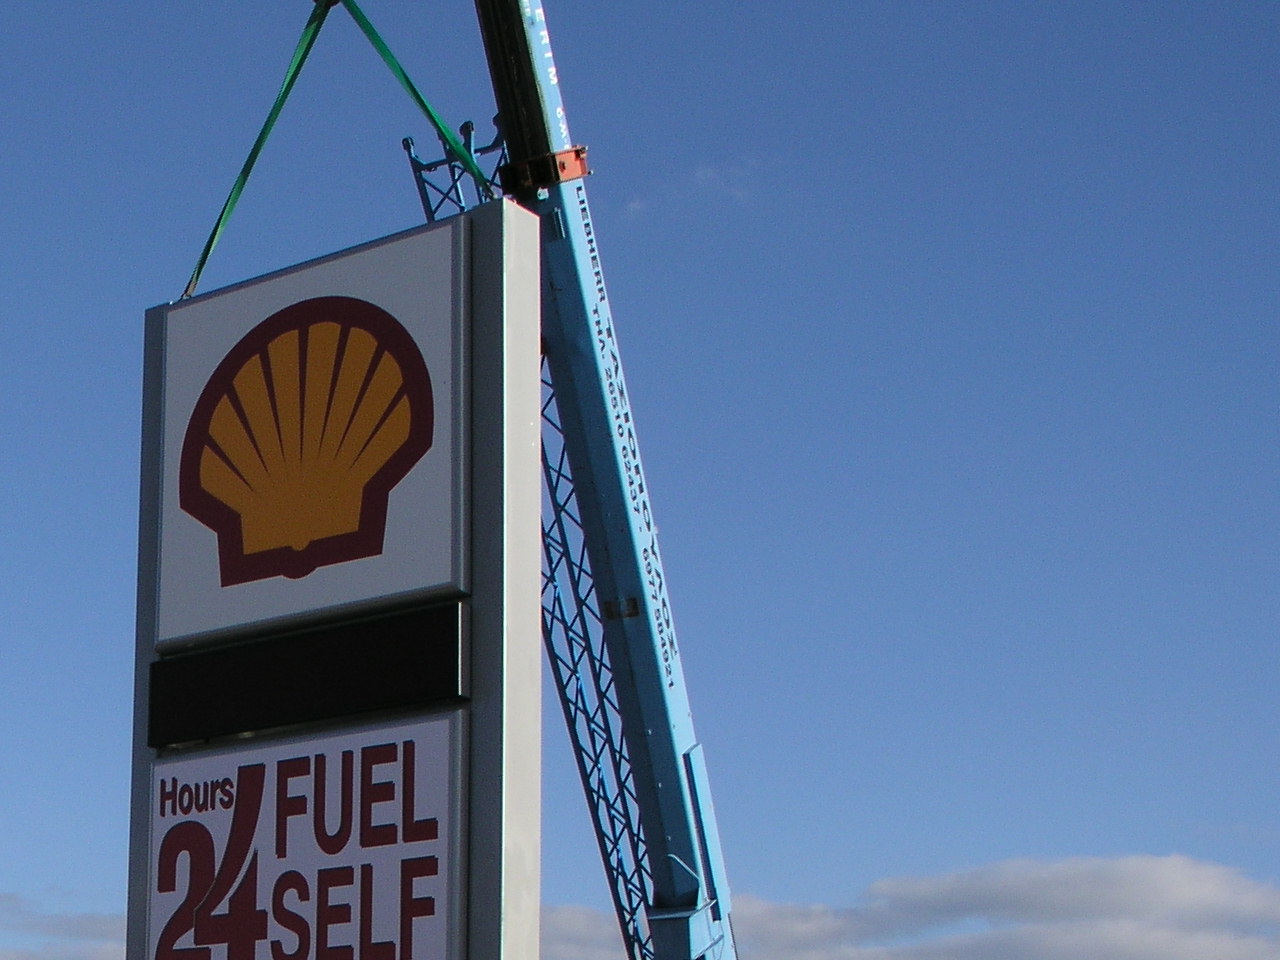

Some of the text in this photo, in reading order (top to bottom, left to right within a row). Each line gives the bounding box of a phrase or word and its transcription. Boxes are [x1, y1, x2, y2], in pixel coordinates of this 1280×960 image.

[576, 186, 606, 302] LIEBHERR
[605, 367, 624, 438] 26510
[159, 777, 234, 817] Hours
[275, 740, 438, 859] FUEL
